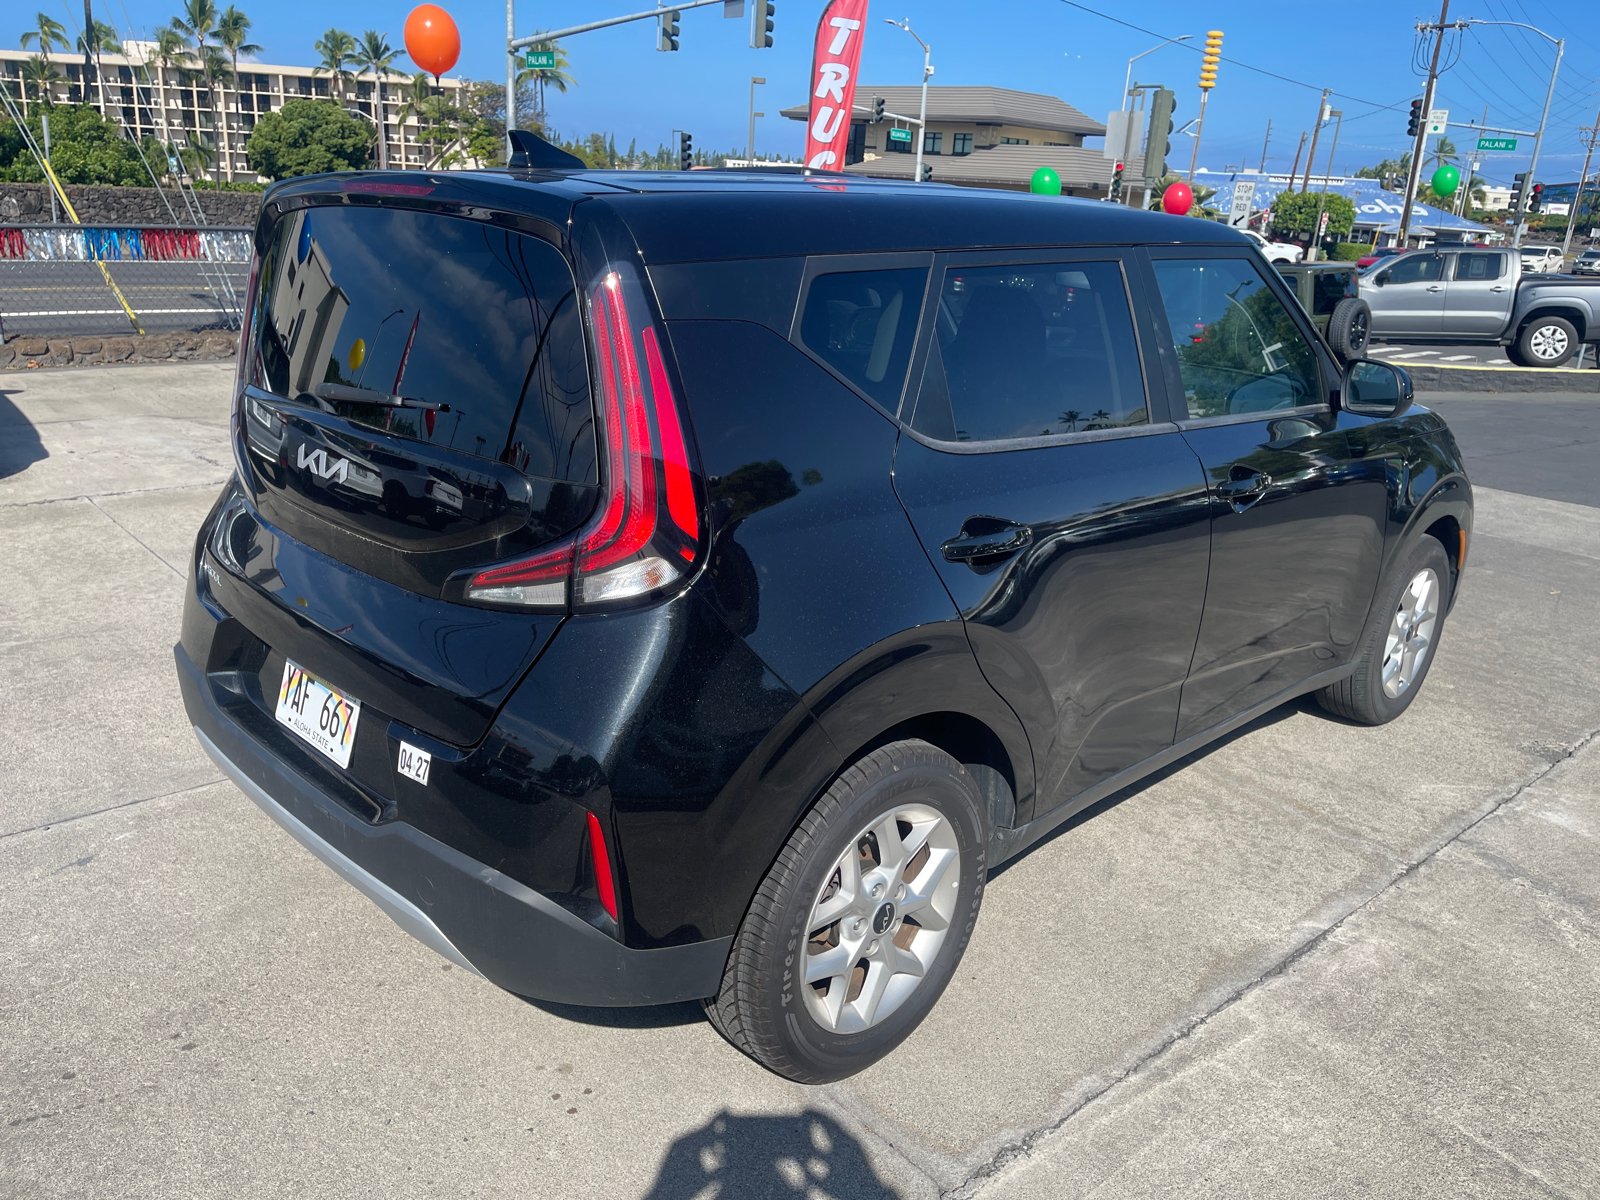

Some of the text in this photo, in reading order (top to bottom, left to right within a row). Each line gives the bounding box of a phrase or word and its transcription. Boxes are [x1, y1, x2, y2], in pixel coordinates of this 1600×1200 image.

[527, 56, 548, 65] PALANI
[1480, 140, 1507, 148] PALANI
[1237, 184, 1253, 194] STOP
[1235, 203, 1247, 212] RED
[297, 443, 350, 485] KIA
[284, 665, 355, 746] YAF 667
[293, 718, 329, 750] ALOHA STATE
[400, 748, 430, 781] 04 27
